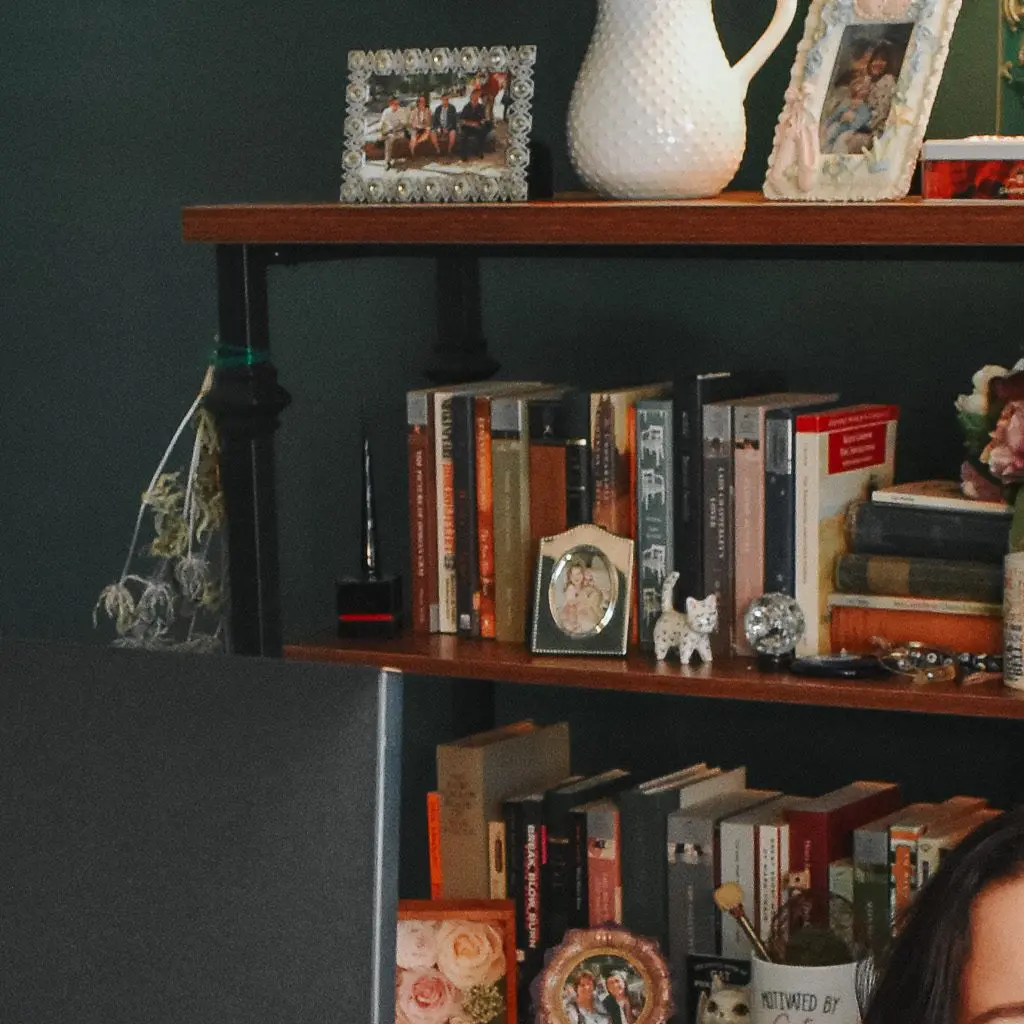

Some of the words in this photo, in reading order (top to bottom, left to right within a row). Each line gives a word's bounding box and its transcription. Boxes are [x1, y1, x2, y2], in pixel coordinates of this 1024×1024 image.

[528, 913, 537, 948] BURN
[762, 990, 817, 1013] MOTIVATED
[822, 995, 841, 1015] BY
